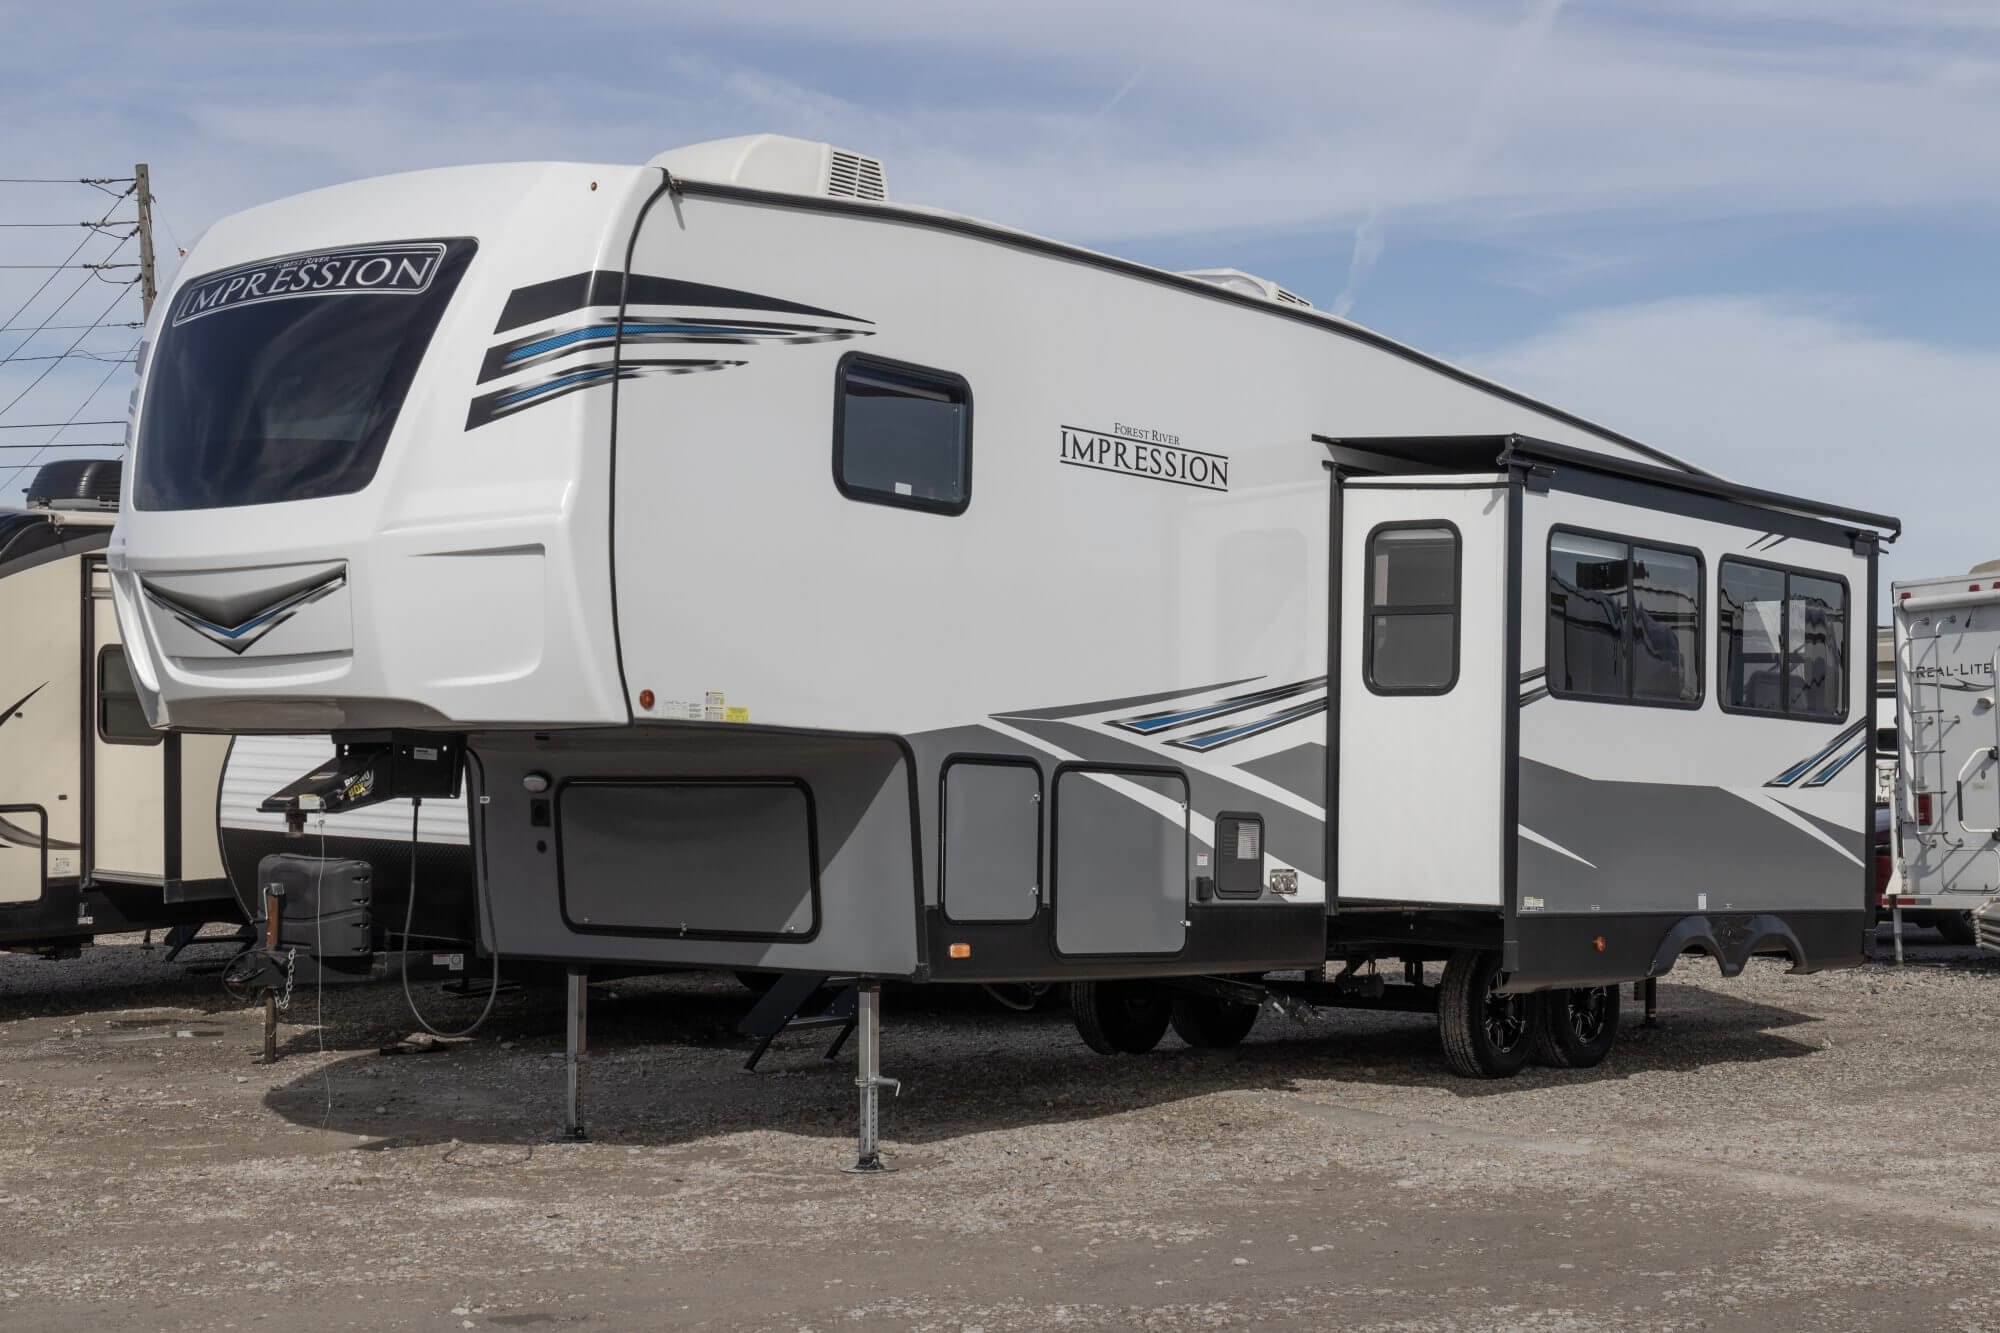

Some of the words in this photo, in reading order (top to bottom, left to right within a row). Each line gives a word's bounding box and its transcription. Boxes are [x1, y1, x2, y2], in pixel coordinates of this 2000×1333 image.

[178, 255, 434, 319] IMPRESSION
[1060, 430, 1229, 487] IMPRESSION
[1114, 422, 1149, 440] FOREST
[1151, 429, 1180, 446] RIVER
